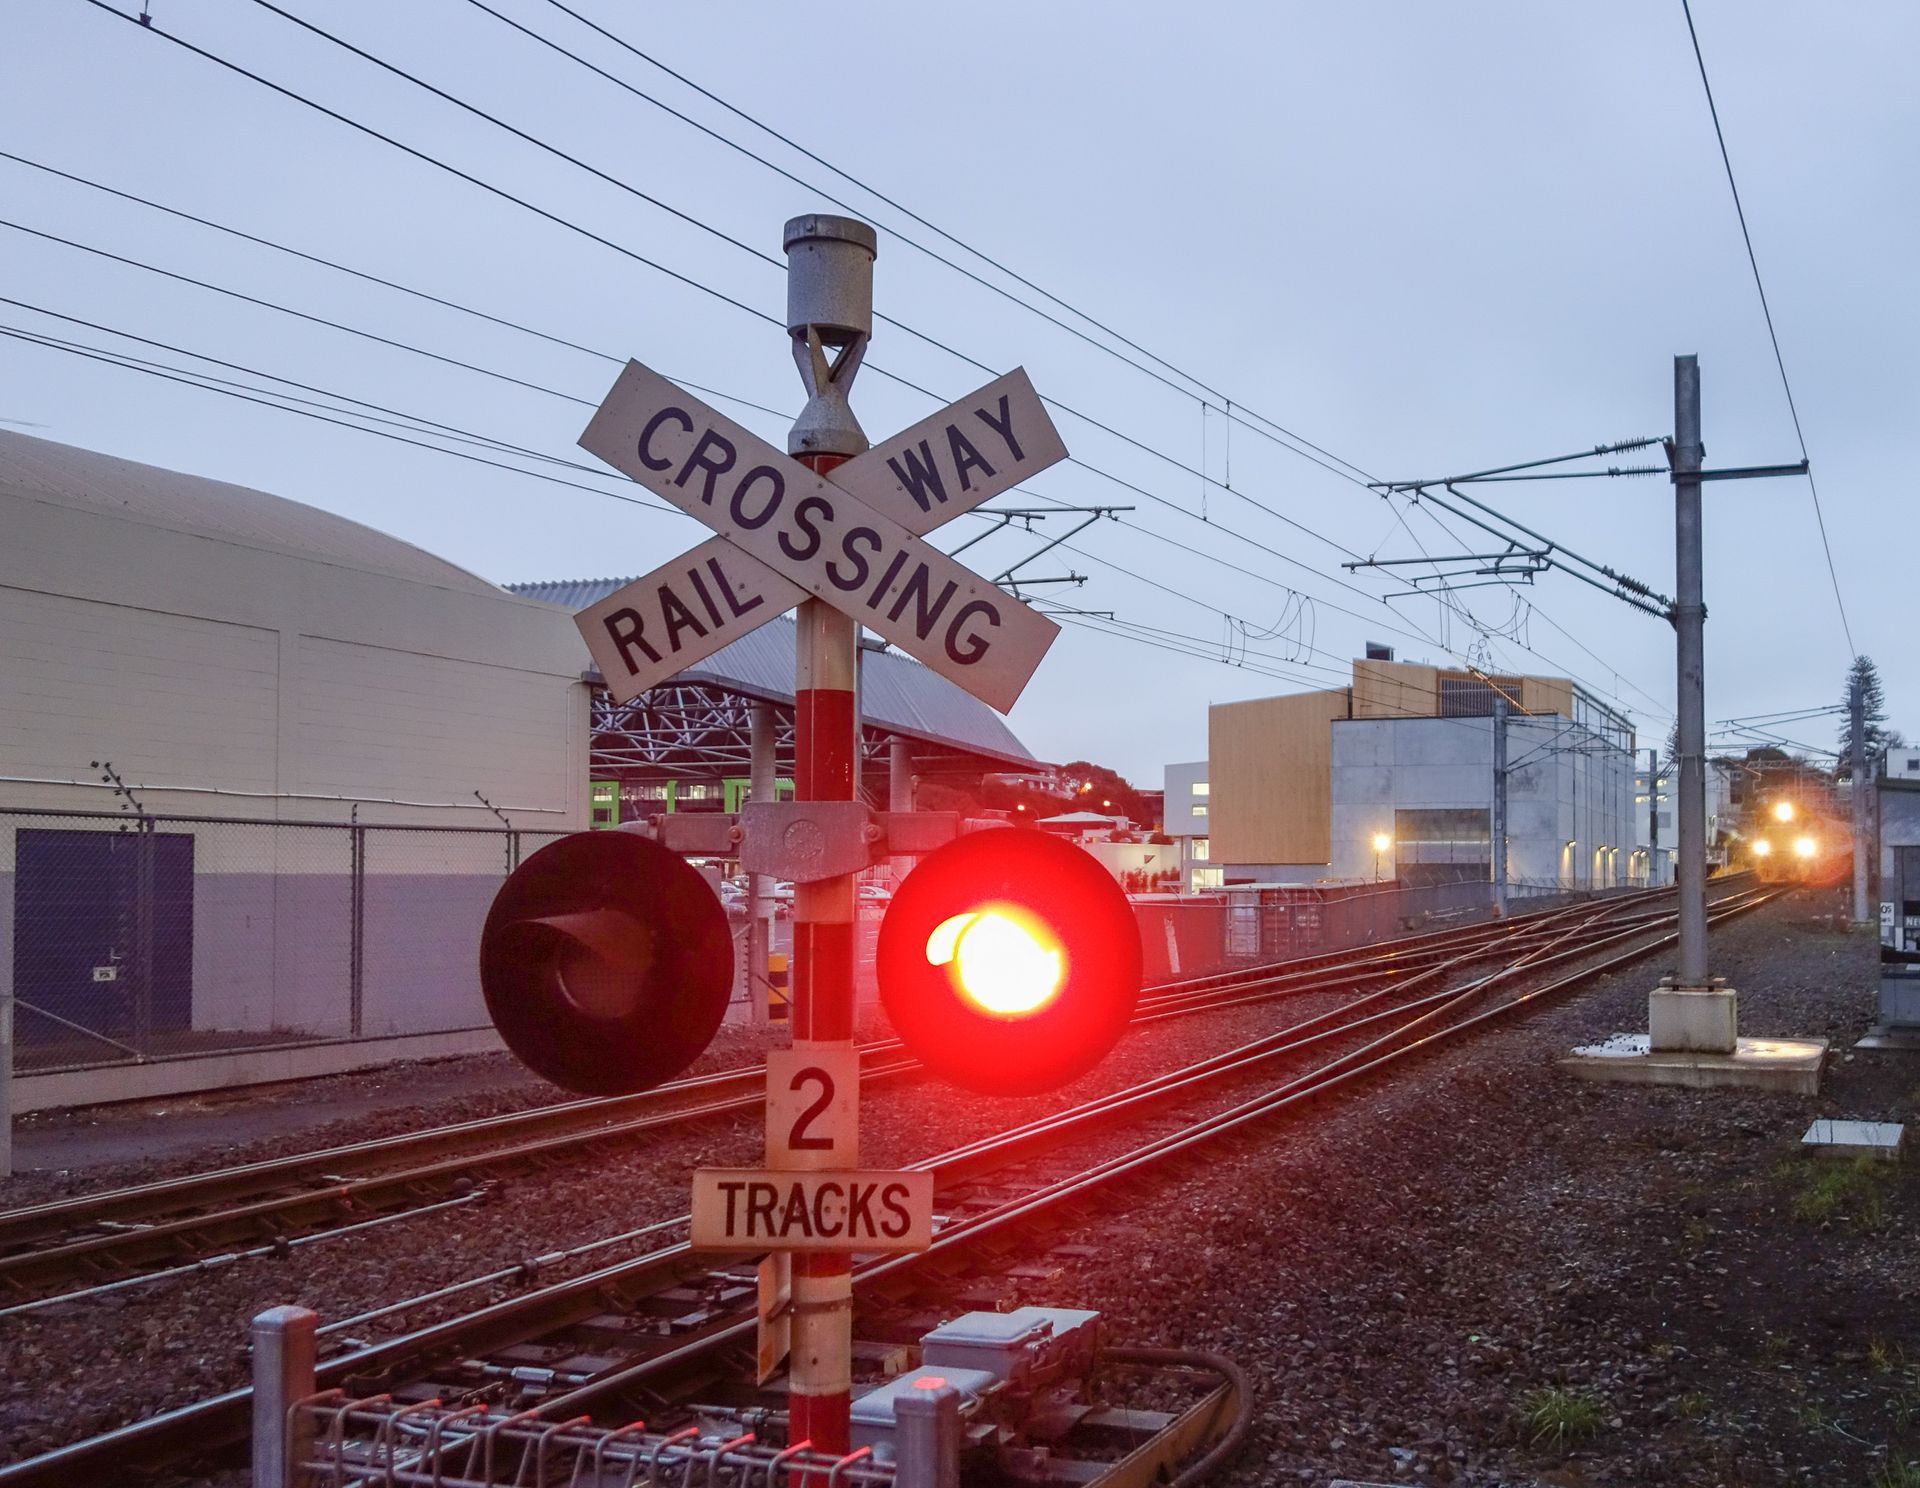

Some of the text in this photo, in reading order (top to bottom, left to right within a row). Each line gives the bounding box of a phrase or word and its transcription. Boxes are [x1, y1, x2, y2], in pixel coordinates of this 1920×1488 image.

[887, 395, 1026, 513] WAY
[637, 406, 1001, 666] CROSSING
[603, 557, 765, 676] RAIL
[788, 1066, 835, 1151] 2
[717, 1181, 912, 1239] TRACKS
